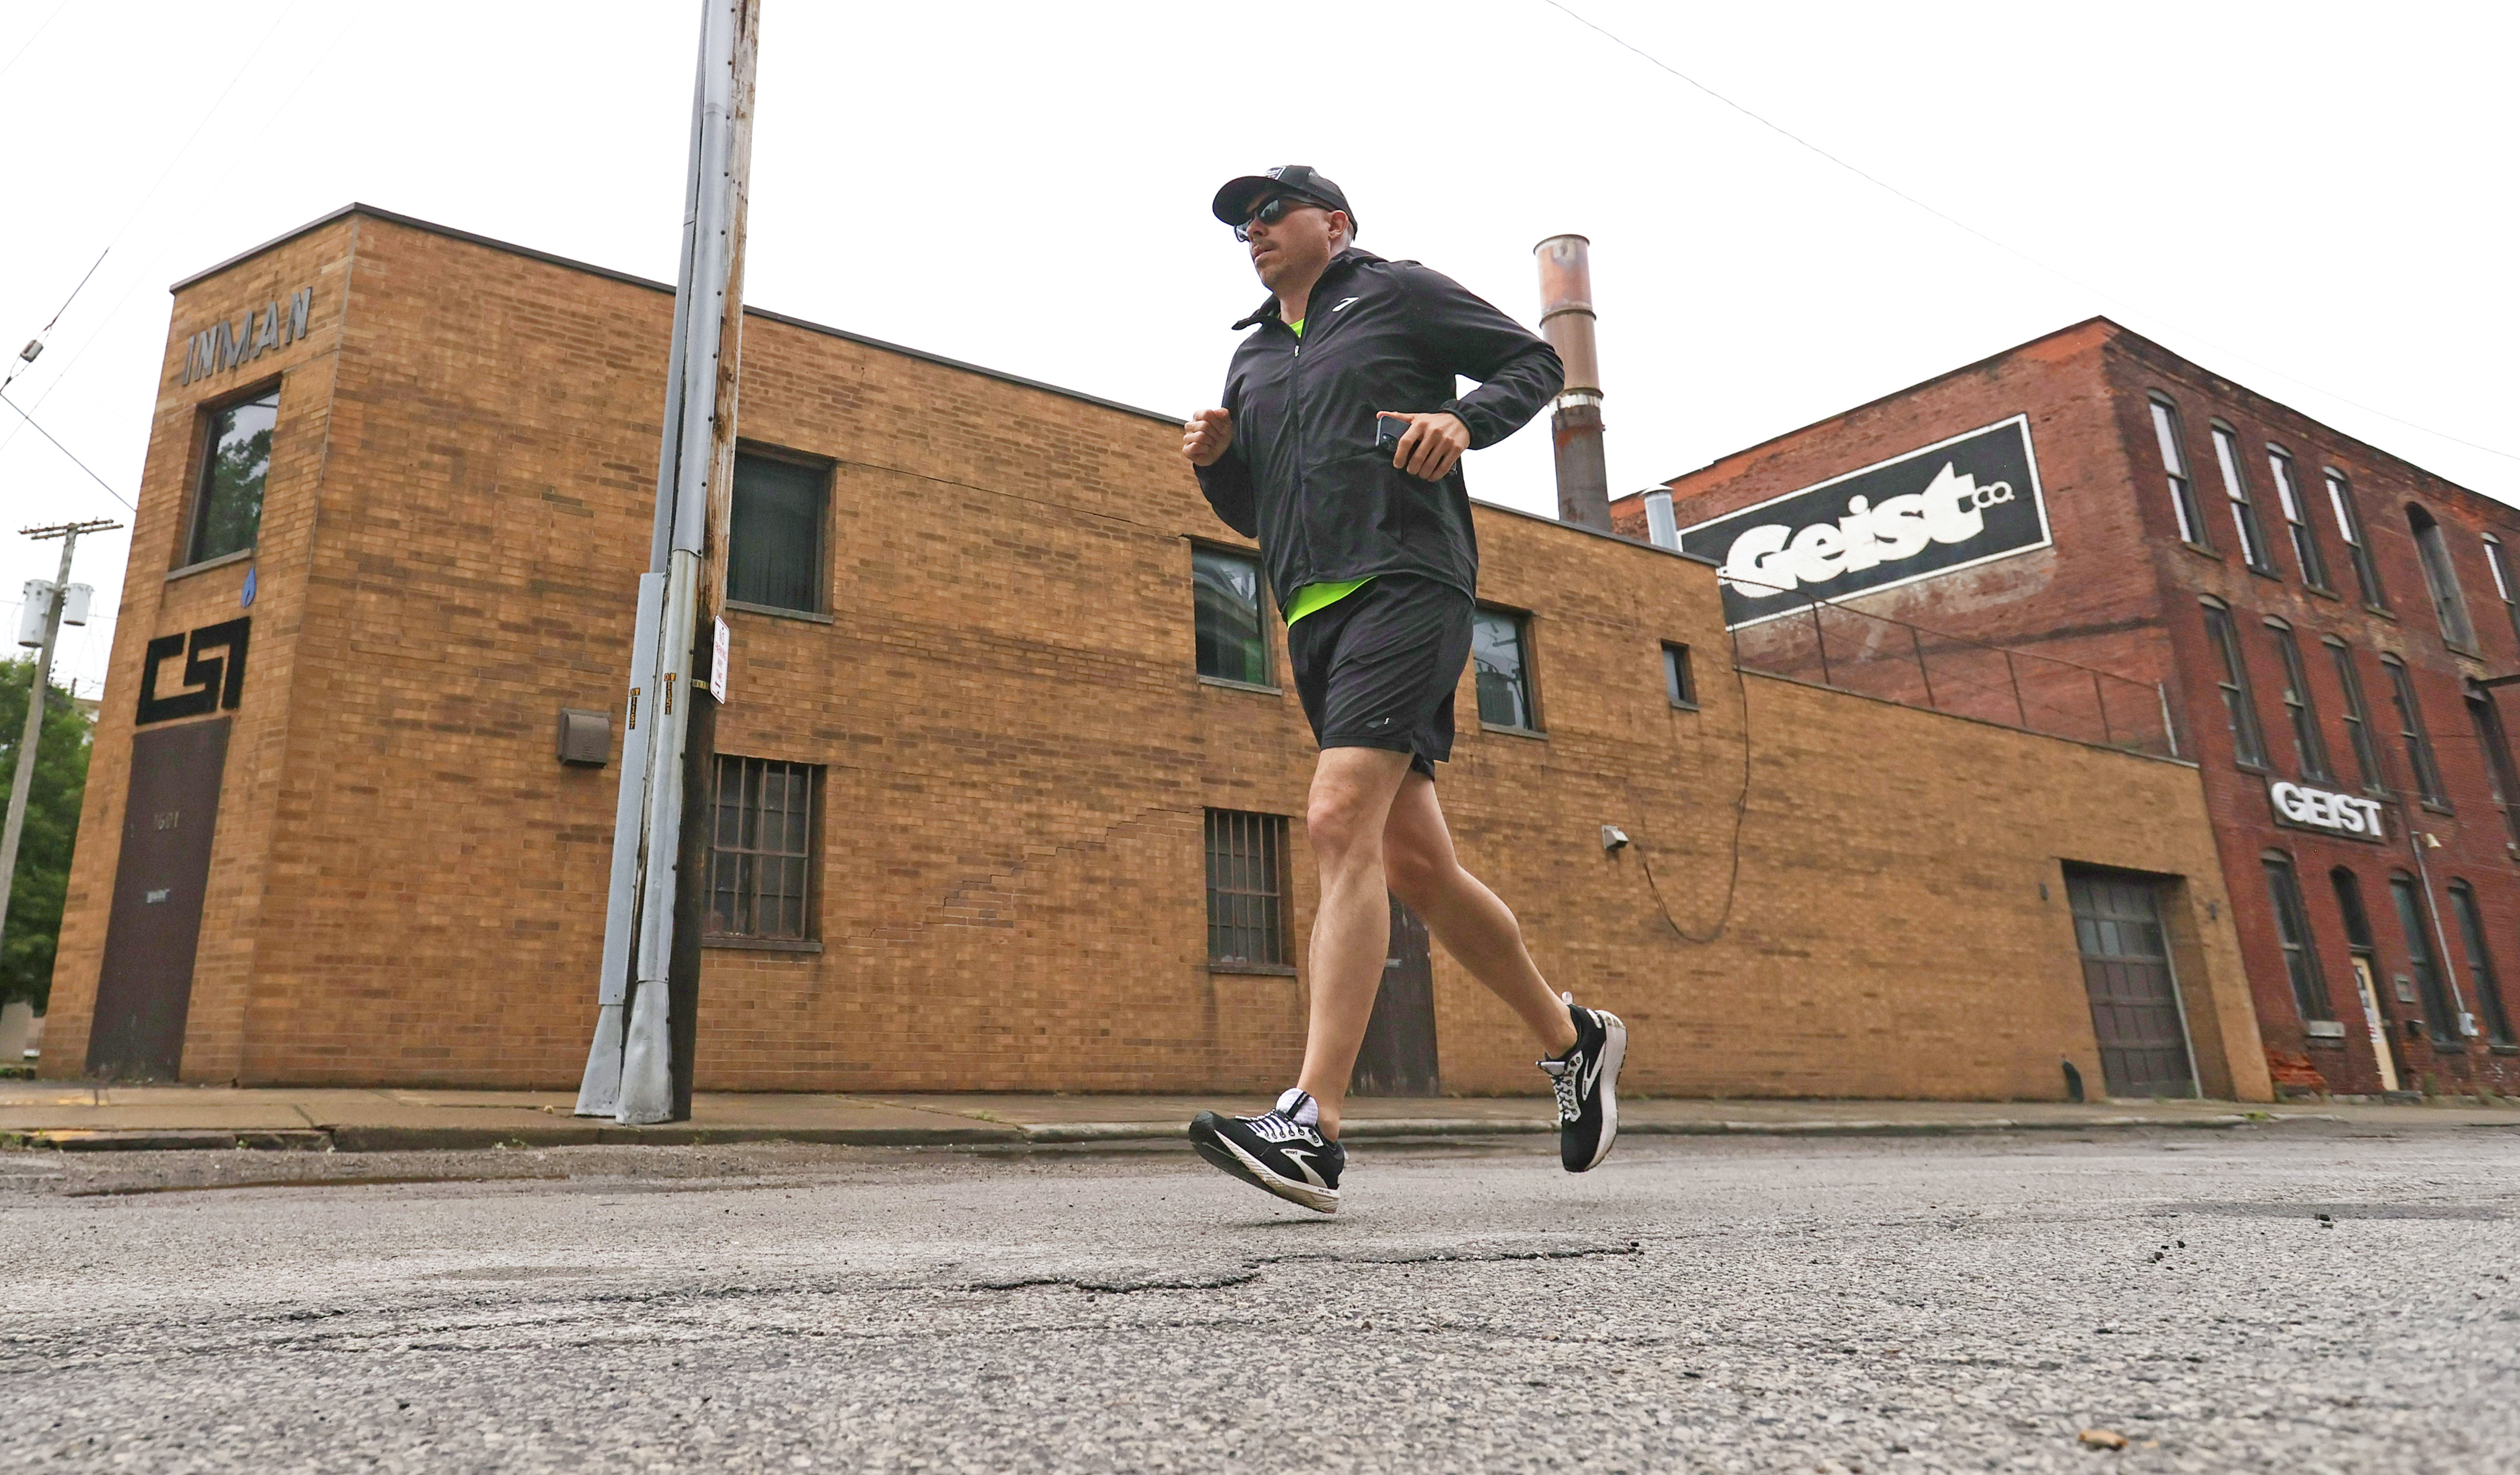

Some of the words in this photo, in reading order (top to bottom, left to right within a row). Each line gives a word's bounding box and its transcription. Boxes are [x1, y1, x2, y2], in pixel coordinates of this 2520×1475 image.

[182, 286, 312, 387] INMAN
[1726, 460, 1985, 598] Geist
[2271, 781, 2382, 837] GEIST
